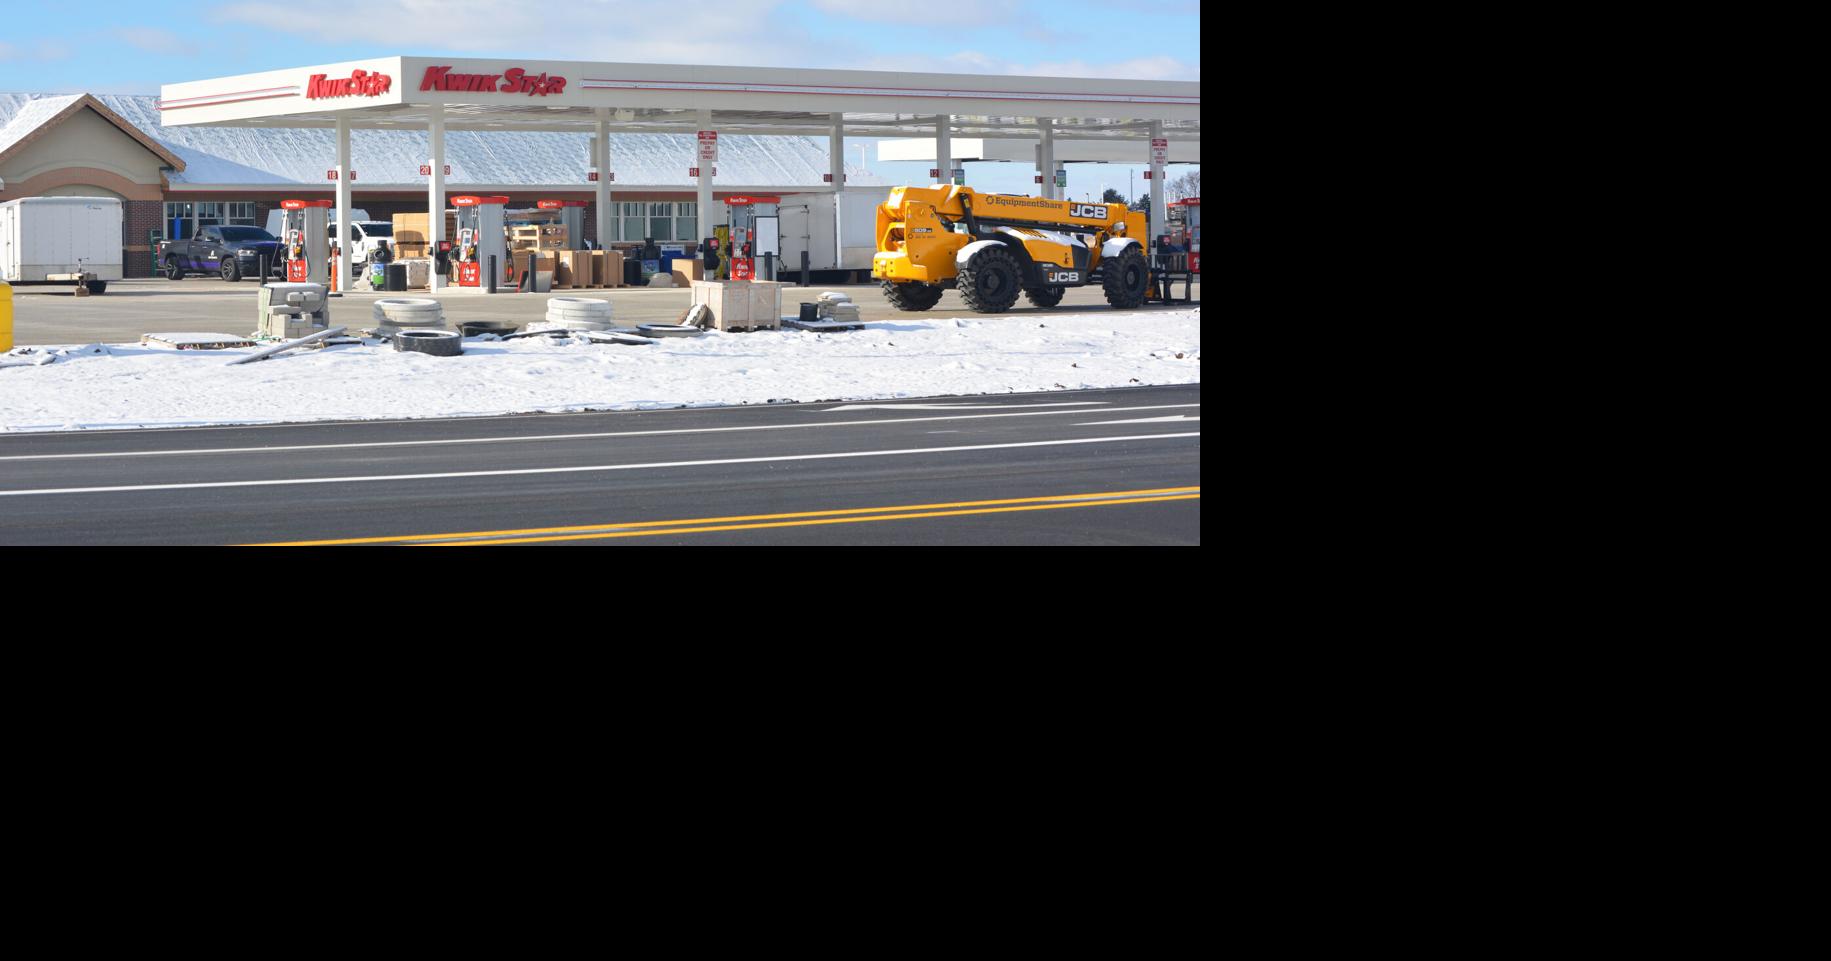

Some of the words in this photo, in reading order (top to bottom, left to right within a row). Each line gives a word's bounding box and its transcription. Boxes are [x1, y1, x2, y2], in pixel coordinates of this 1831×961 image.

[995, 196, 1063, 209] EquipmentShare
[1070, 204, 1107, 219] JCB
[1048, 272, 1079, 282] JCB
